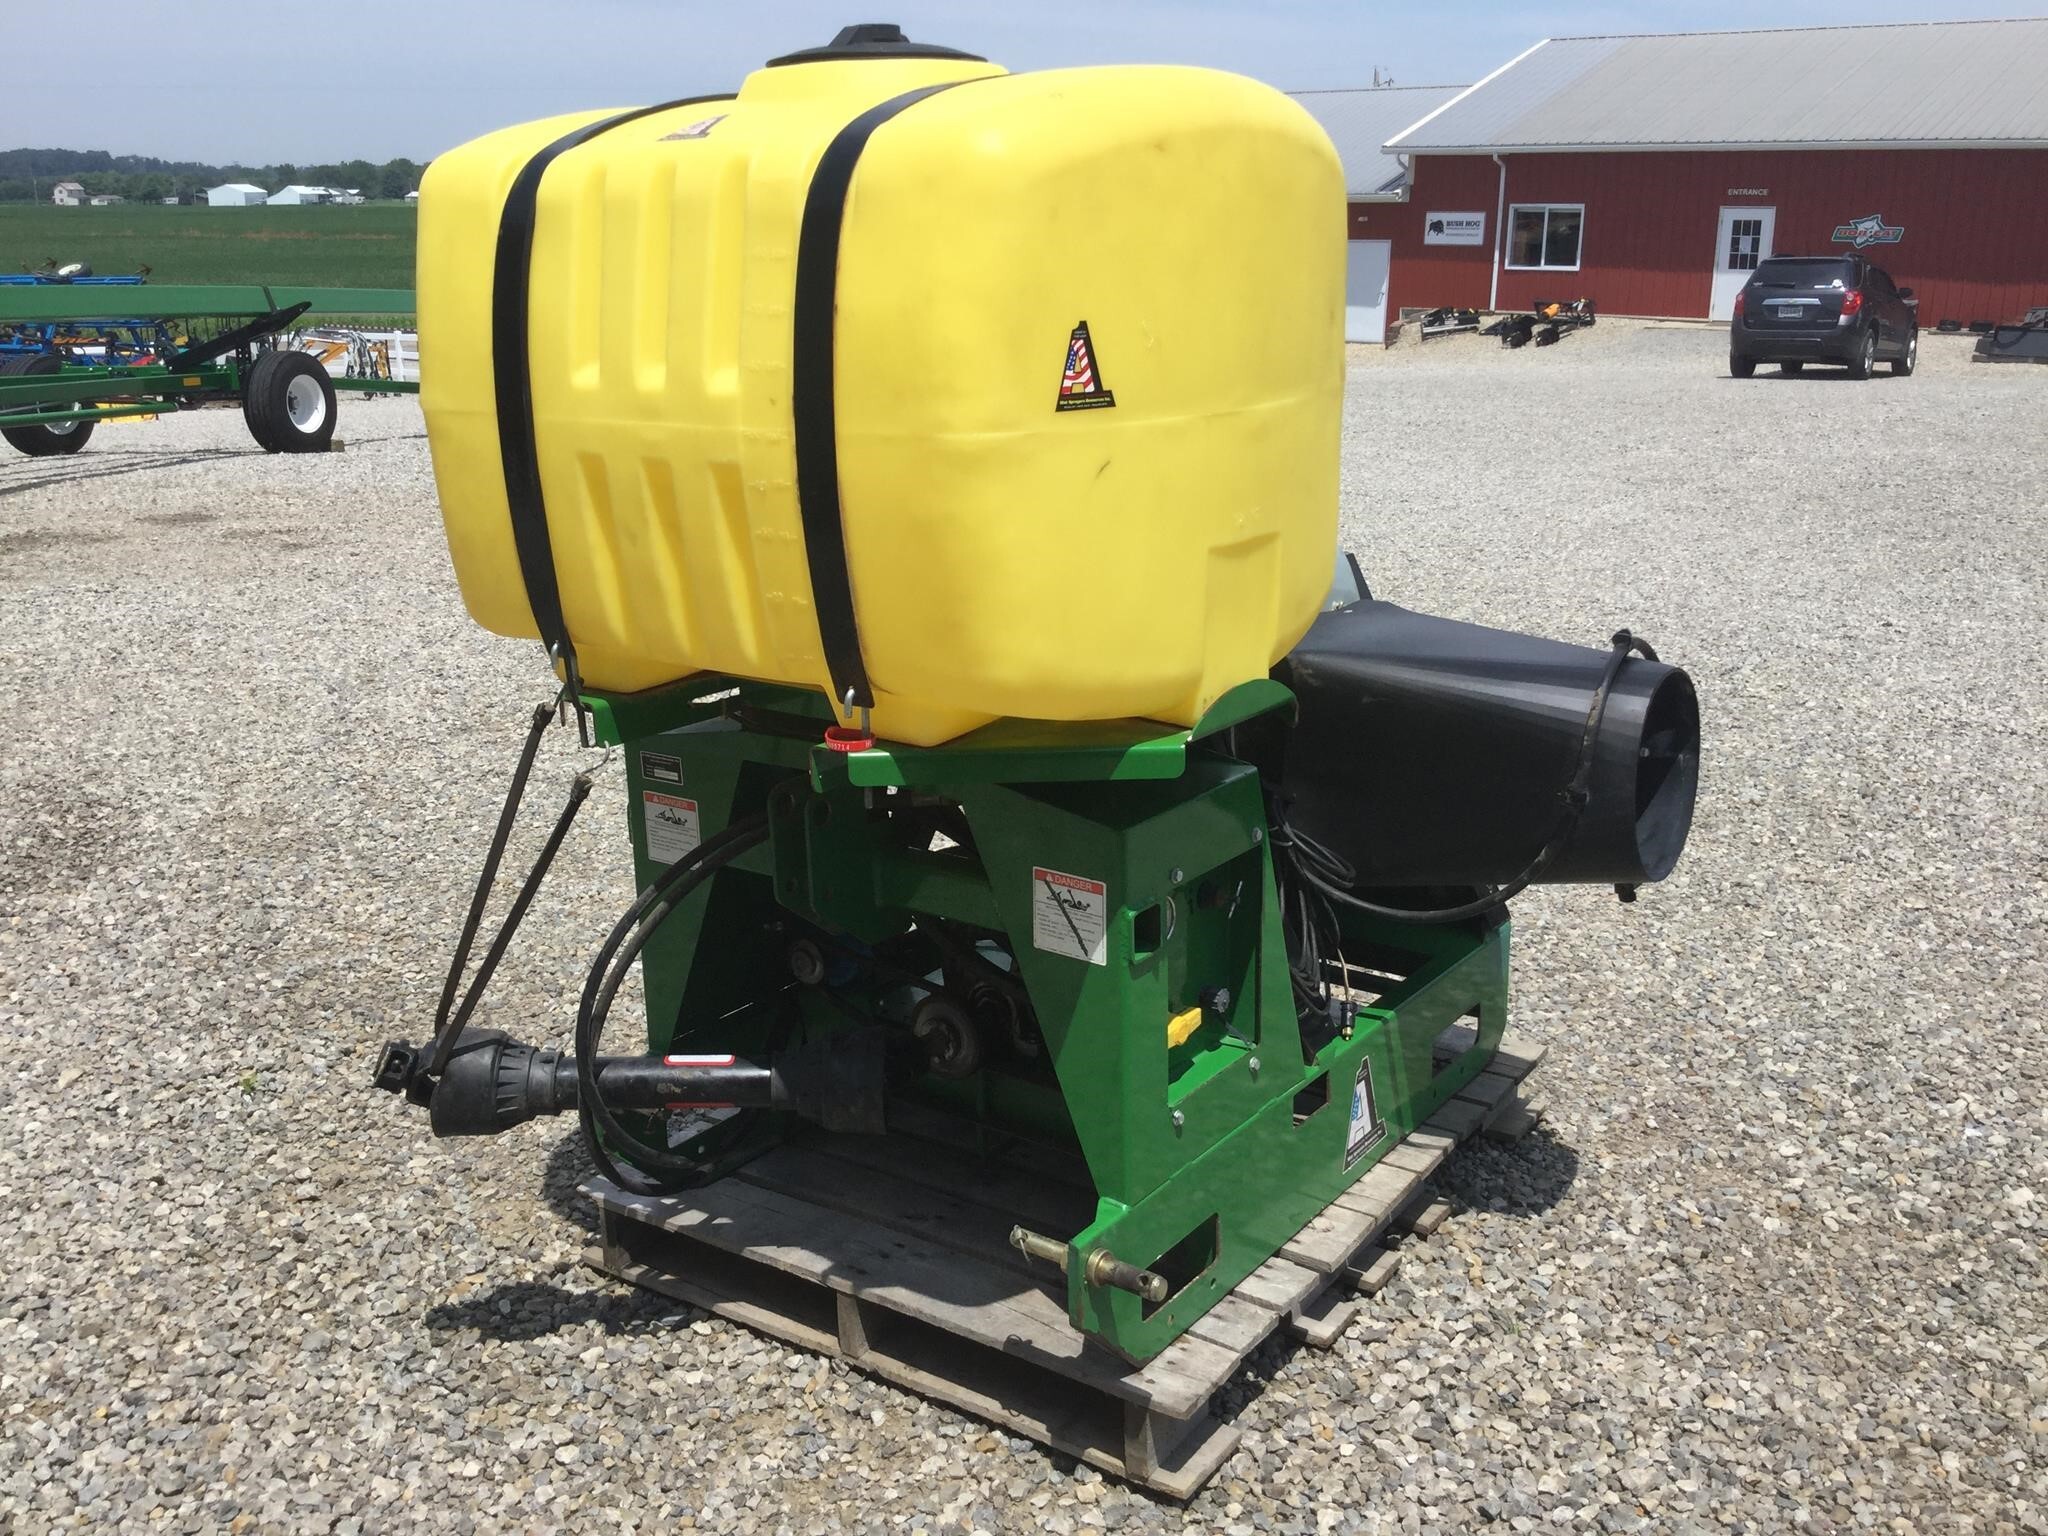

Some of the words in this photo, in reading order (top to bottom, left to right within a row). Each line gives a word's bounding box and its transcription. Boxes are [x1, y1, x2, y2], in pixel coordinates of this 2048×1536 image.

[1728, 188, 1768, 196] ENTRANCE
[657, 796, 690, 810] DANGER
[1054, 875, 1093, 891] DANGER
